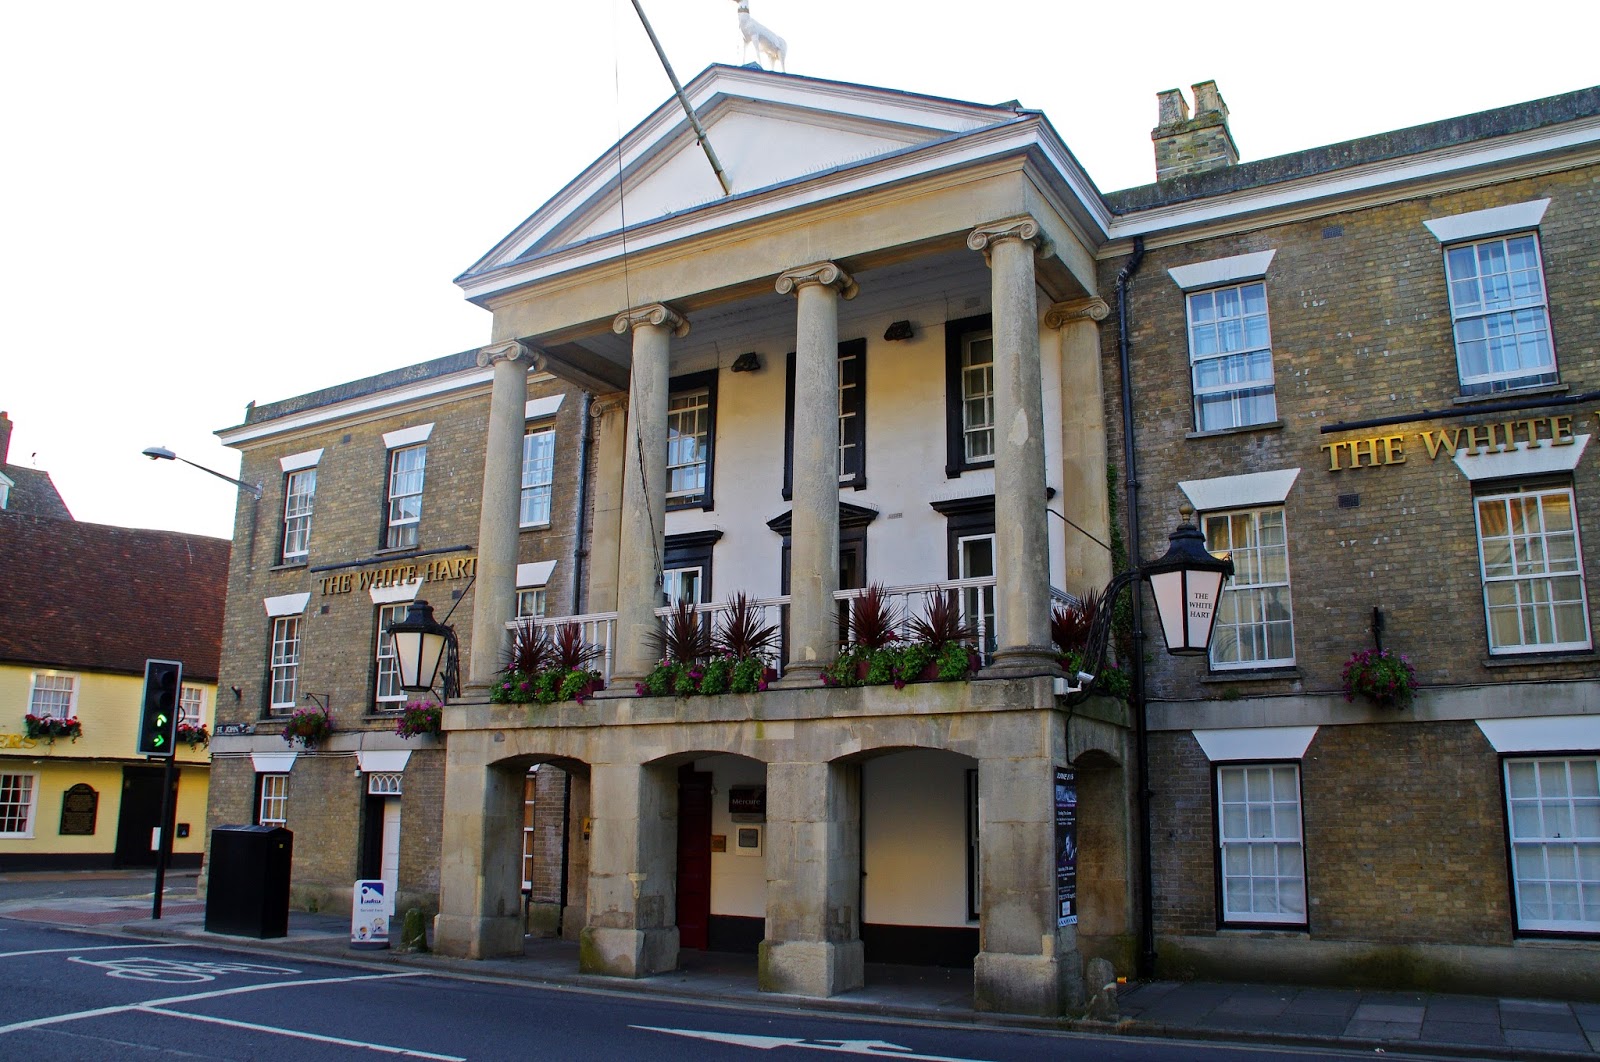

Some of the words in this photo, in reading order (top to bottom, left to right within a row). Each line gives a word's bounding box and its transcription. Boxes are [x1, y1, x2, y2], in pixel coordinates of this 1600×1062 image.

[1320, 435, 1407, 472] THE
[1420, 415, 1575, 460] WHITE
[319, 574, 352, 596] THE
[357, 564, 418, 591] WHITE
[424, 556, 478, 583] HART
[1194, 592, 1209, 600] THE
[1189, 601, 1213, 609] WHITE
[1190, 610, 1210, 619] HART
